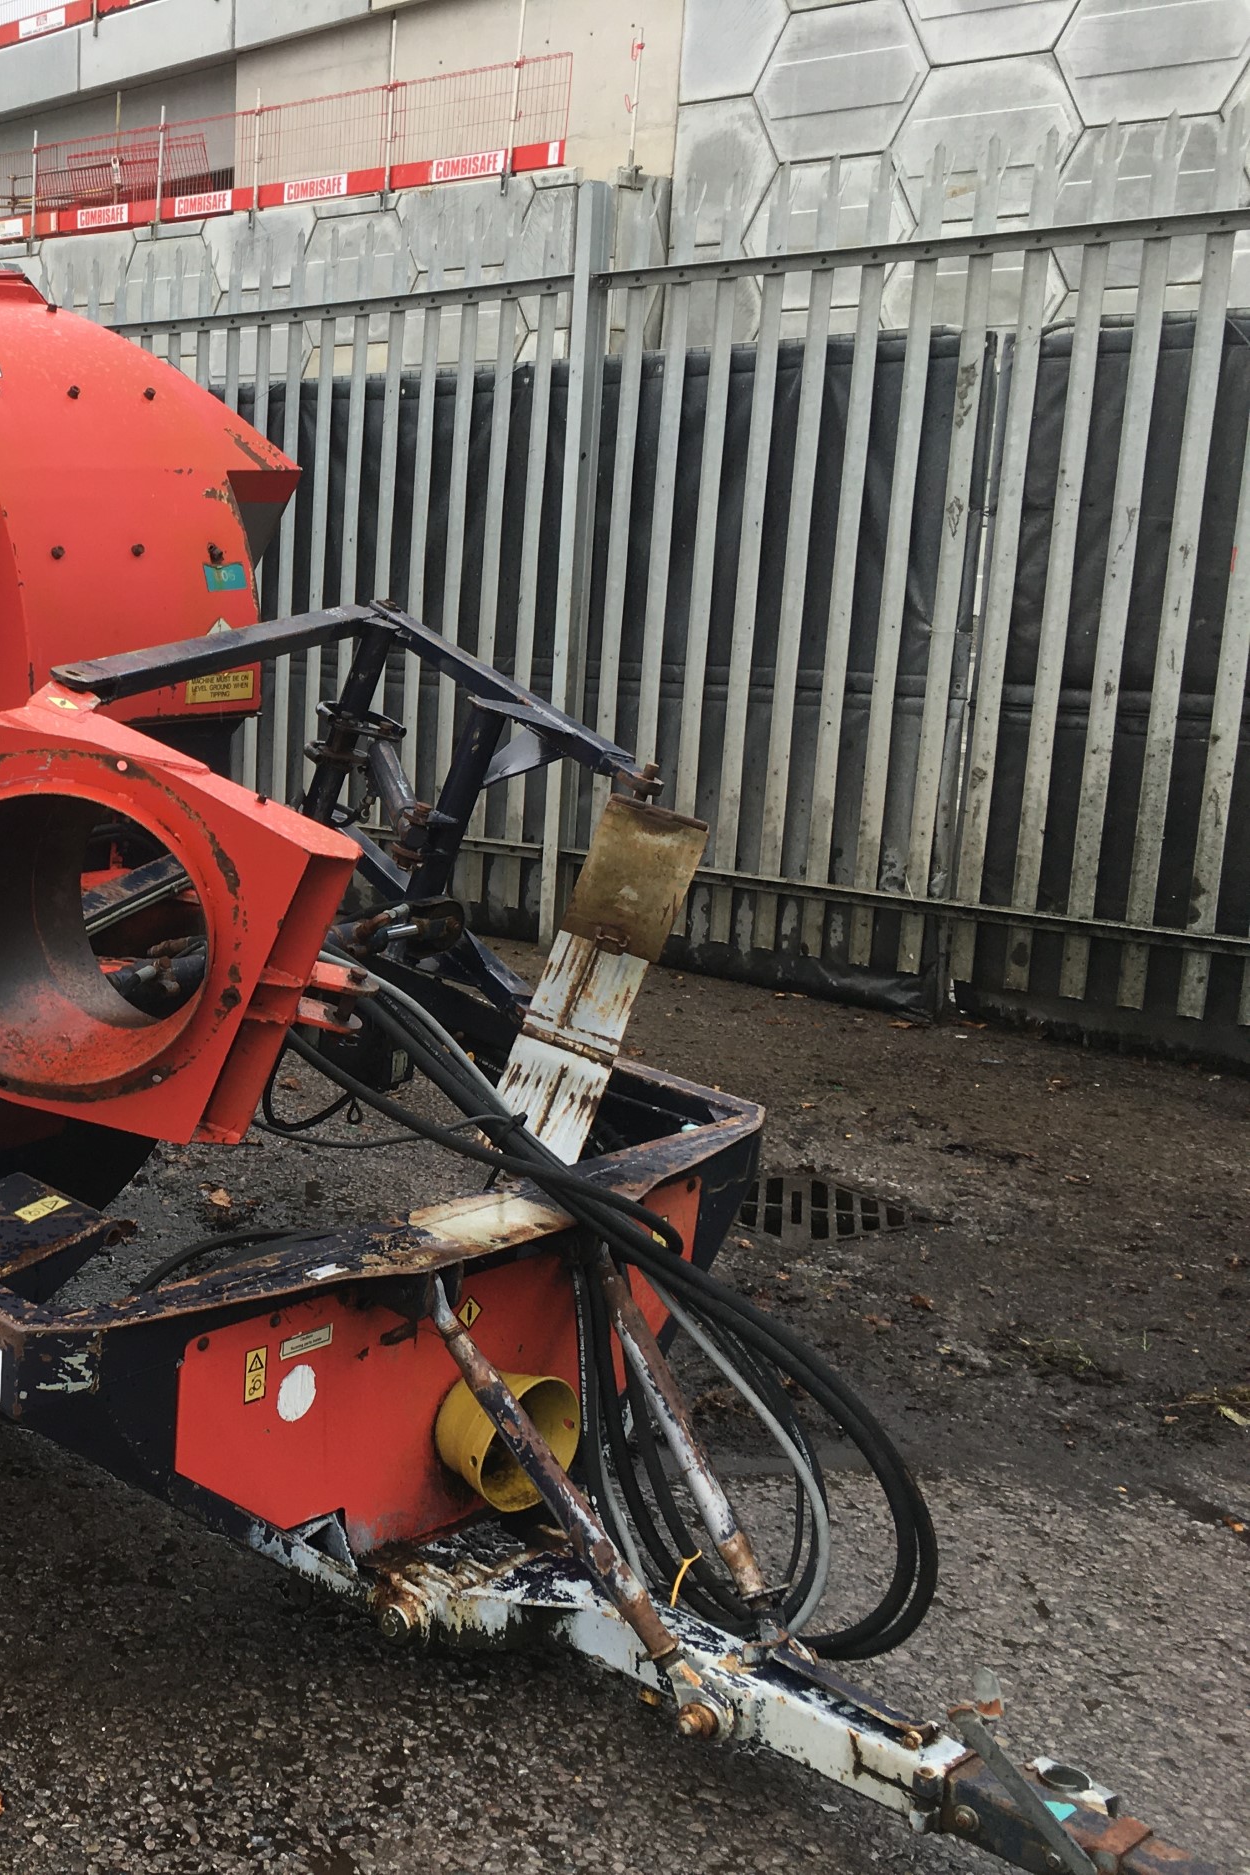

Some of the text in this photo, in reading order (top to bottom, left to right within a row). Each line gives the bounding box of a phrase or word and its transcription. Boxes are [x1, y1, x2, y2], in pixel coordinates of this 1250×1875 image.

[435, 153, 499, 179] COMBISAFE
[287, 176, 342, 200] COMBISAFE
[177, 192, 227, 215] COMBISAFE
[79, 206, 124, 227] COMBISAFE
[191, 676, 215, 685] MACHINE
[216, 675, 231, 683] MUST
[232, 674, 240, 682] BE
[191, 685, 208, 693] LEVEL
[209, 683, 232, 691] GROUND
